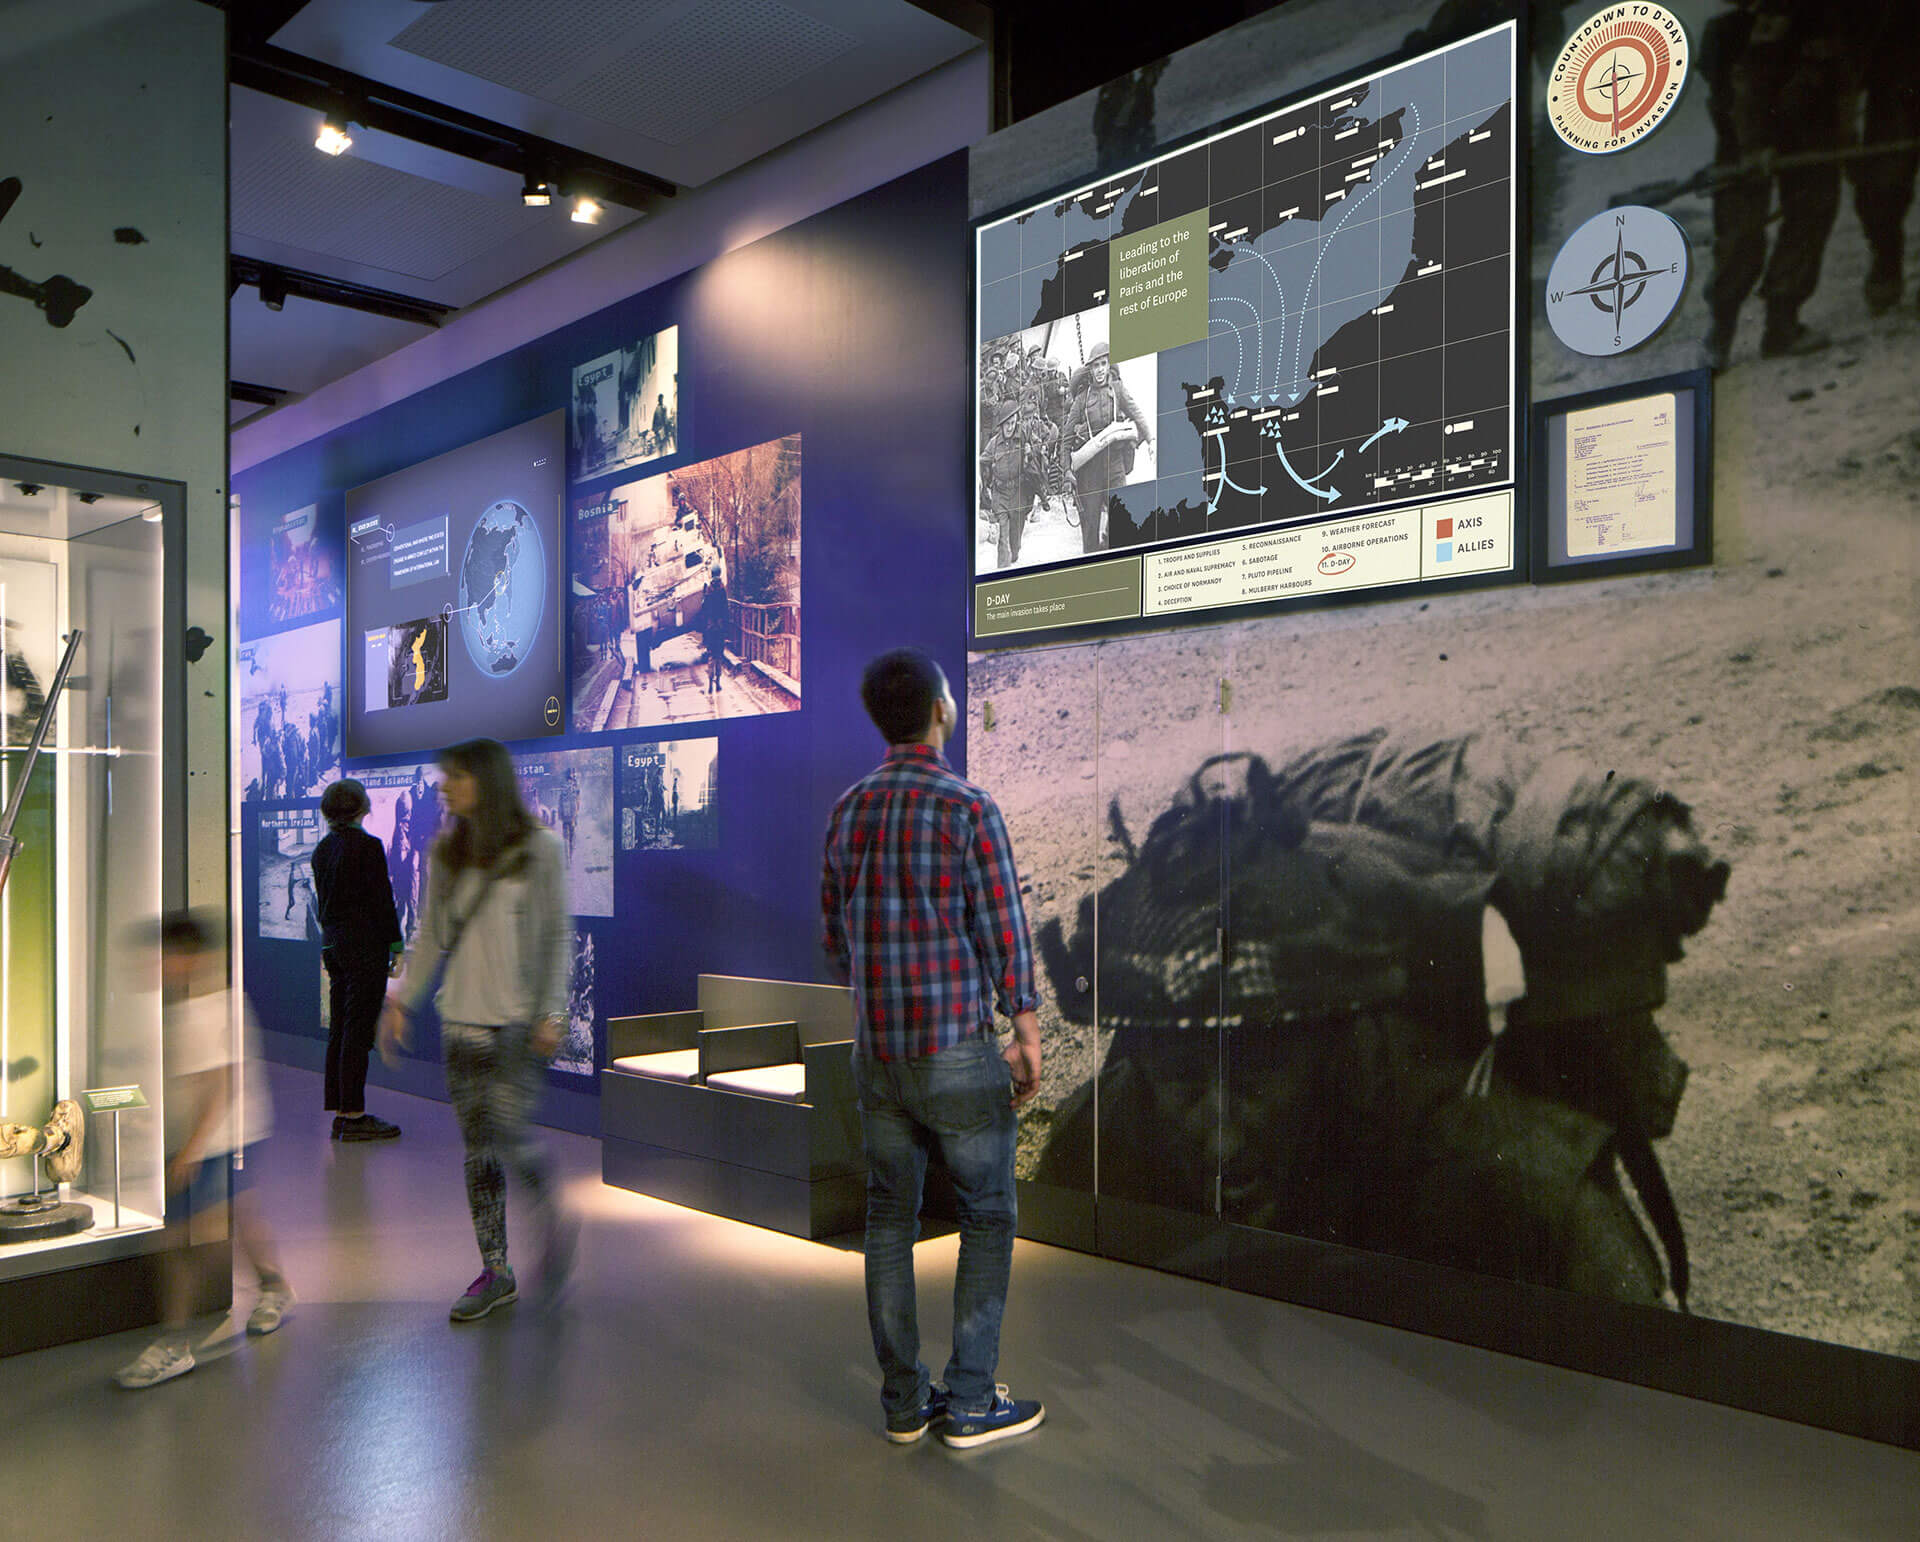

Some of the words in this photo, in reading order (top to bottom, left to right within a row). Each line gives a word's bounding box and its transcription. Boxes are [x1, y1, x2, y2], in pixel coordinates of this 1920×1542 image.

[1554, 7, 1625, 82] COUNTDOWN
[1633, 6, 1649, 16] TO
[1652, 10, 1683, 45] D-DAY
[1555, 115, 1599, 149] PLANNING
[1604, 136, 1626, 149] FOR
[1631, 82, 1679, 138] INVASION
[1615, 215, 1625, 227] N
[1120, 241, 1158, 262] Leading
[1160, 237, 1170, 248] to
[1173, 230, 1190, 244] the
[1120, 257, 1166, 280] liberation
[1169, 249, 1180, 263] of
[1671, 262, 1678, 274] E
[1120, 282, 1143, 298] Paris
[1145, 274, 1164, 290] and
[1166, 270, 1183, 283] the
[1120, 302, 1138, 316] rest
[1140, 296, 1151, 310] of
[1153, 288, 1188, 306] Europe
[1550, 291, 1564, 304] W
[1614, 336, 1622, 347] S
[1329, 525, 1360, 536] WEATHER
[1361, 519, 1396, 530] FORECAST
[1458, 517, 1483, 530] AXIS
[1248, 535, 1302, 549] RECONNAISSANCE
[1321, 545, 1331, 553] 10.
[1332, 539, 1365, 552] AIRBORNE
[1366, 533, 1409, 546] OPERATIONS
[1457, 539, 1494, 553] ALLIES
[1163, 555, 1183, 564] TROOPS
[1184, 553, 1195, 561] AND
[1196, 549, 1220, 559] SUPPLIES
[1248, 554, 1278, 565] SABOTAGE
[1330, 558, 1351, 567] D-DAY
[1163, 569, 1173, 578] AIR
[1173, 568, 1185, 576] AND
[1186, 566, 1202, 574] NAVAL
[1204, 561, 1236, 572] SUPREMACY
[1247, 571, 1265, 580] PLUTO
[1266, 566, 1293, 576] PIPELINE
[1163, 583, 1183, 592] CHOICE
[1183, 581, 1191, 589] OF
[1191, 577, 1222, 588] NORMANDY
[1248, 585, 1278, 594] MULBERRY
[1279, 580, 1312, 590] HARBOURS
[986, 593, 1010, 606] D-DAY
[1163, 596, 1192, 606] DECEPTION
[997, 611, 1010, 619] main
[1011, 608, 1032, 617] invasion
[1033, 604, 1049, 614] takes
[1049, 602, 1065, 613] place
